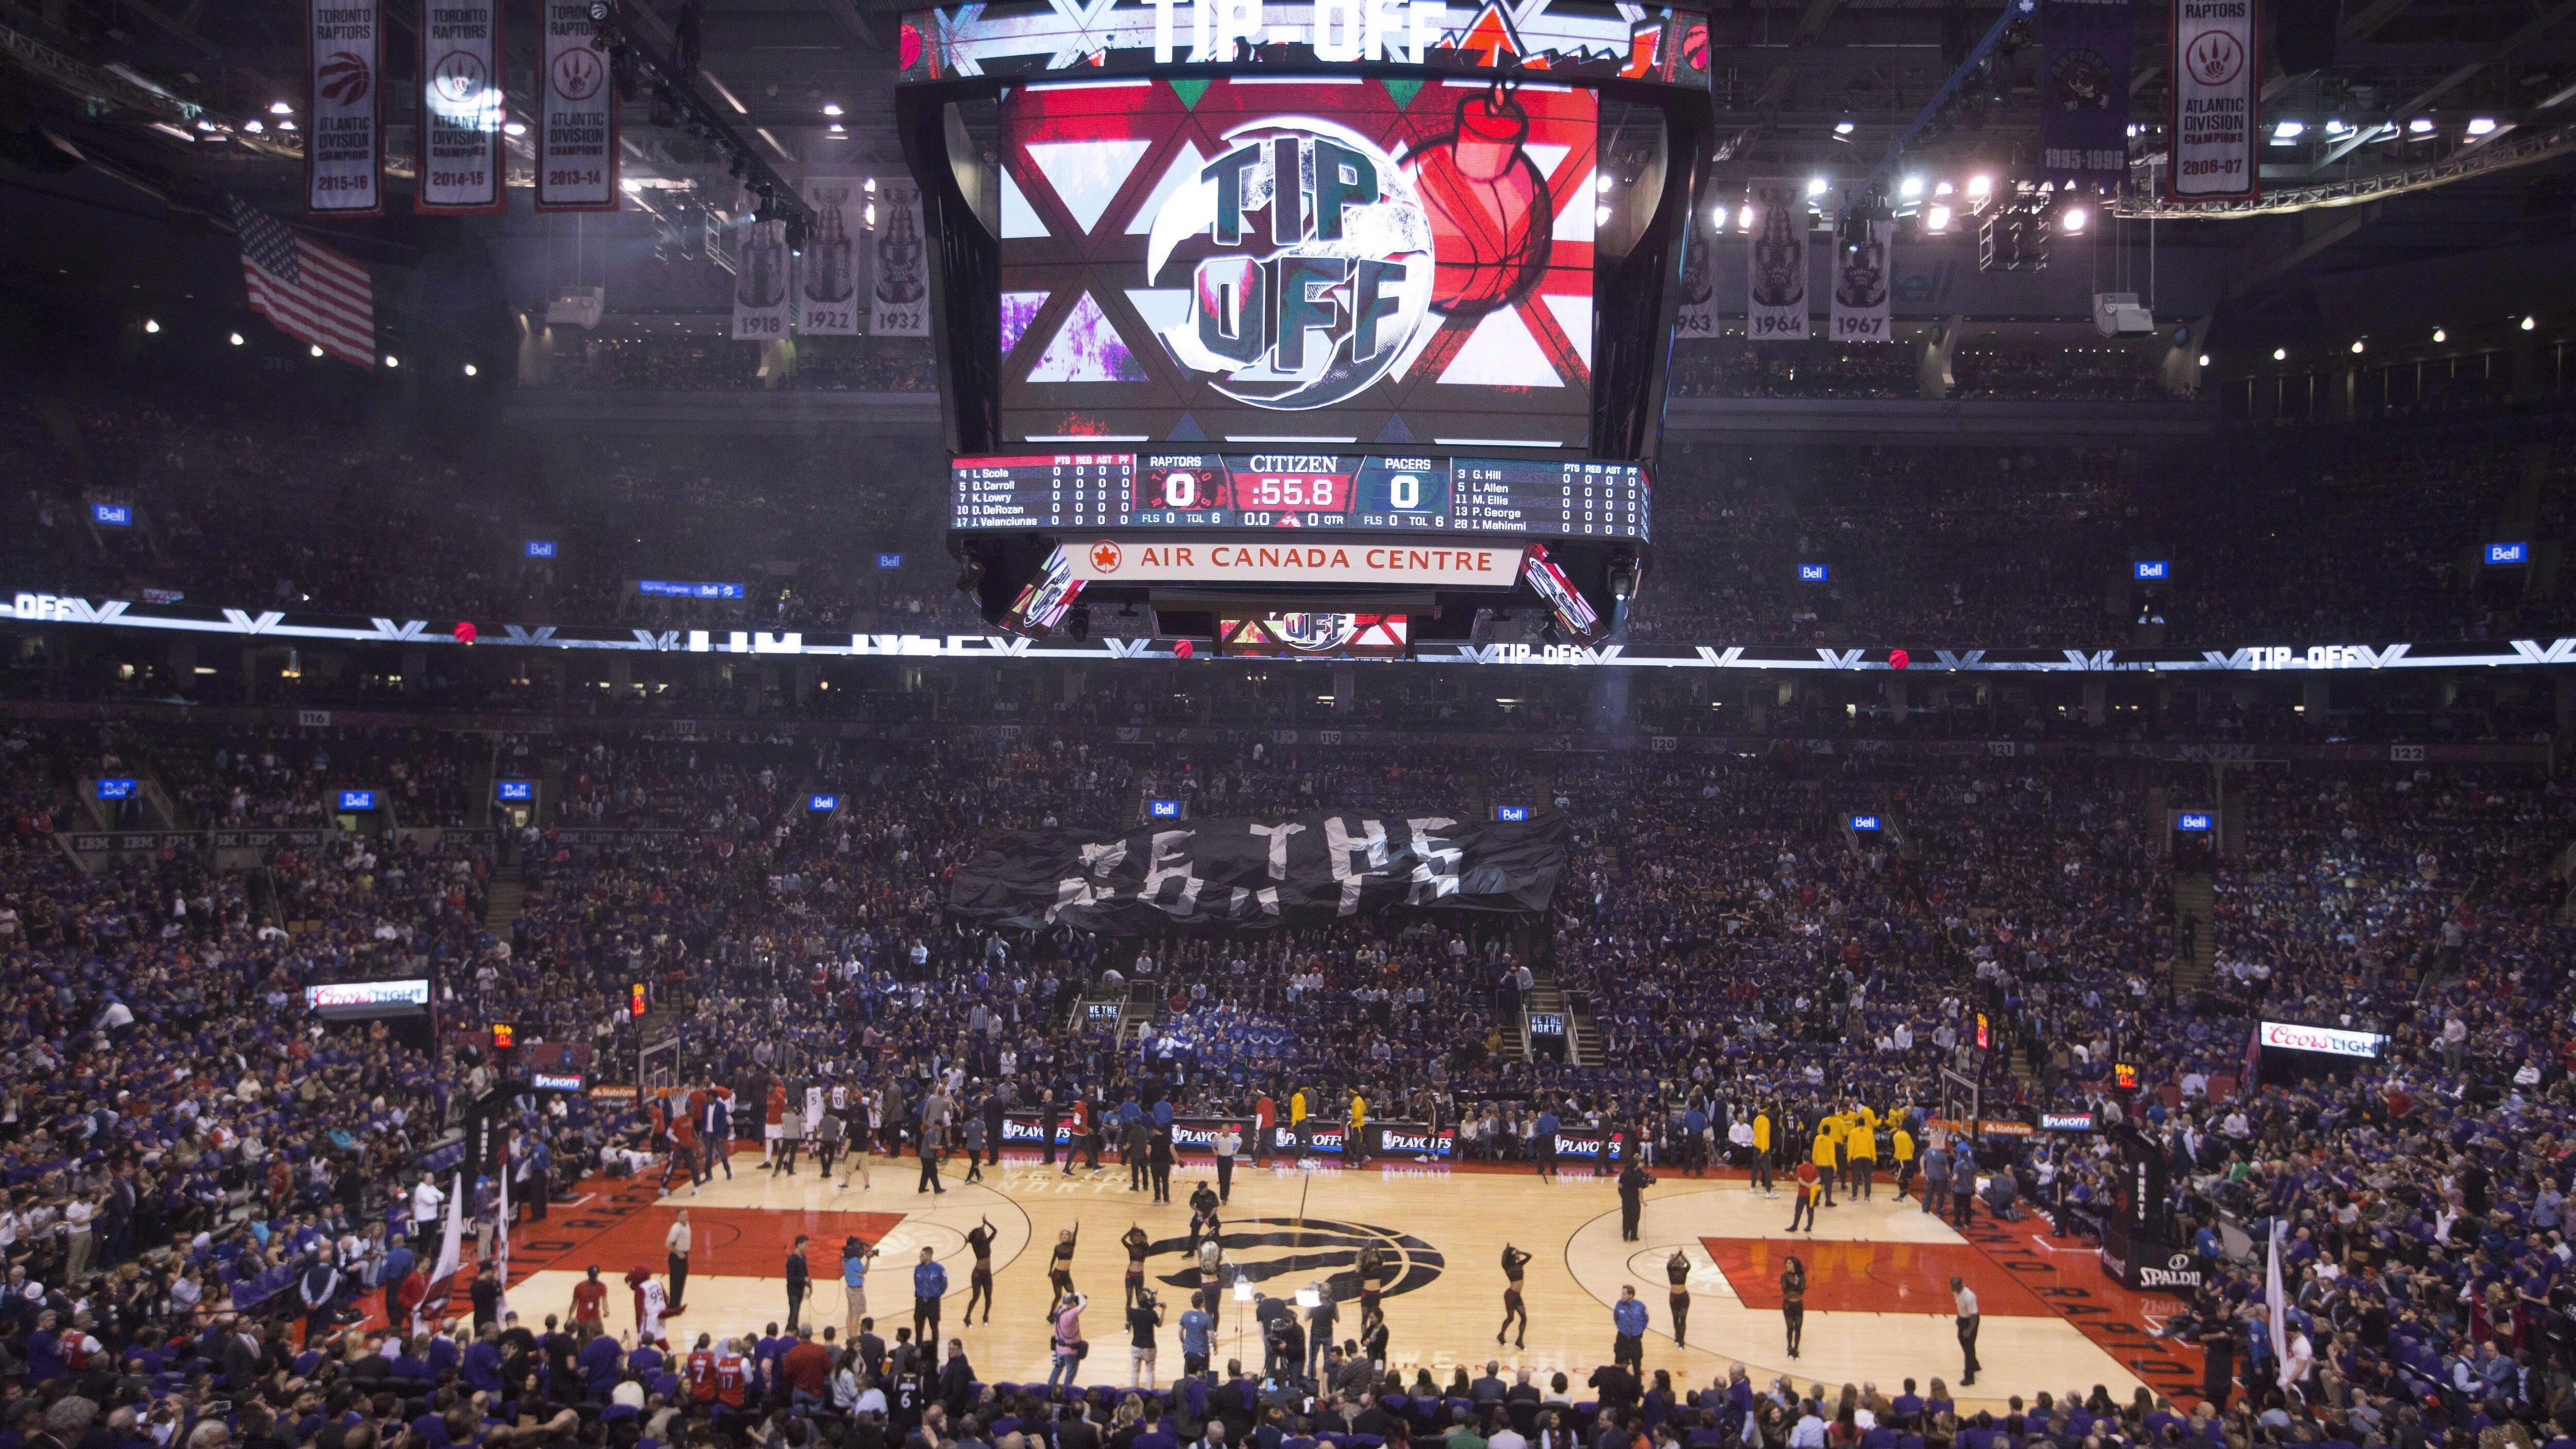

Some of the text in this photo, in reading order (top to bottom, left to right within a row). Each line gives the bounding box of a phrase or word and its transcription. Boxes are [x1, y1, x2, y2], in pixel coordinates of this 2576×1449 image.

[318, 9, 370, 22] TORONTO
[434, 9, 487, 22] TORONTO
[2186, 3, 2245, 19] RAPTORS
[317, 25, 370, 39] RAPTORS
[433, 25, 487, 39] RAPTORS
[2185, 98, 2244, 114] ATLANTIC
[320, 117, 369, 130] ATLANTIC
[551, 113, 604, 126] ATLANTIC
[2184, 115, 2243, 131] DIVISION
[318, 133, 368, 148] DIVISION
[432, 131, 486, 145] DIVISION
[550, 129, 603, 144] DIVISION
[2184, 133, 2243, 145] CHAMPIONS
[2183, 159, 2242, 176] 2006-07
[318, 176, 368, 191] 2015-16
[433, 172, 485, 186] 2014-15
[550, 170, 601, 185] 2013-14
[1201, 134, 1380, 246] TIP
[1194, 255, 1407, 371] OFF
[742, 317, 780, 334] 1918
[807, 312, 850, 330] 1922
[879, 313, 922, 330] 1932
[1678, 314, 1711, 331] 963
[1755, 316, 1802, 333] 1964
[1838, 318, 1883, 334] 1967
[1055, 456, 1070, 465] PTS
[1150, 457, 1201, 467] RAPTORS
[1250, 455, 1337, 472] CITIZEN
[1385, 458, 1430, 470] PACERS
[960, 466, 1129, 478] 4 L. Scola 0 0 0 0
[1458, 470, 1635, 486] 3 G. Hill 0 0 0 0
[960, 481, 1014, 491] 5 D. Carroll
[1166, 474, 1194, 506] 0
[1253, 479, 1332, 505] :55.8
[1391, 475, 1418, 508] 0
[1458, 482, 1508, 492] 5 L. Allen
[960, 493, 1011, 503] 7 K. Lowry
[1456, 495, 1508, 505] 11 M. Ellis
[99, 507, 125, 522] Bell
[958, 505, 1023, 515] 10 D. DeRozan
[1456, 507, 1520, 519] 13 P. George
[957, 517, 1037, 527] 17 J. Valanciunas
[1166, 513, 1174, 523] 0
[1212, 513, 1220, 523] 6
[1245, 513, 1269, 525] 0.0
[1308, 513, 1343, 526] 0 QTR
[1365, 515, 1444, 526] FLS 0 TOL 6
[1455, 519, 1526, 531] 28 I. Mahinmi
[531, 543, 552, 555] Bell
[2493, 547, 2519, 560] Bell
[881, 555, 899, 567] Bell
[1141, 547, 1493, 571] AIR CANADA CENTRE
[1803, 567, 1822, 578] Bell
[2140, 564, 2162, 576] Bell
[702, 586, 718, 595] Bell
[1284, 613, 1347, 642] OFF
[1495, 644, 1581, 665] TIP-OFF
[2247, 645, 2357, 670] TIP-OFF
[303, 713, 325, 723] 116
[1002, 728, 1019, 738] 118
[1322, 733, 1340, 743] 119
[1653, 739, 1675, 749] 120
[1991, 744, 2011, 754] 121
[2394, 748, 2422, 759] 122
[504, 785, 526, 796] Bell
[346, 794, 368, 806] Bell
[815, 797, 833, 808] Bell
[1156, 804, 1174, 814] Bell
[1503, 809, 1522, 821] Bell
[1855, 817, 1874, 828] Bell
[2183, 814, 2206, 827] Bell
[78, 837, 154, 849] IBM IBM
[1101, 1005, 1117, 1014] THE
[1545, 1015, 1561, 1024] THE
[1532, 1024, 1562, 1033] NORTH
[2270, 1026, 2328, 1049] Coors
[541, 1077, 580, 1088] PLAYOFFS
[2050, 1117, 2090, 1127] PLAYOFFS
[1560, 1138, 1621, 1153] PLAYOFS
[2141, 1267, 2201, 1287] SPALDI
[695, 1367, 705, 1384] 7
[901, 1392, 911, 1409] 6
